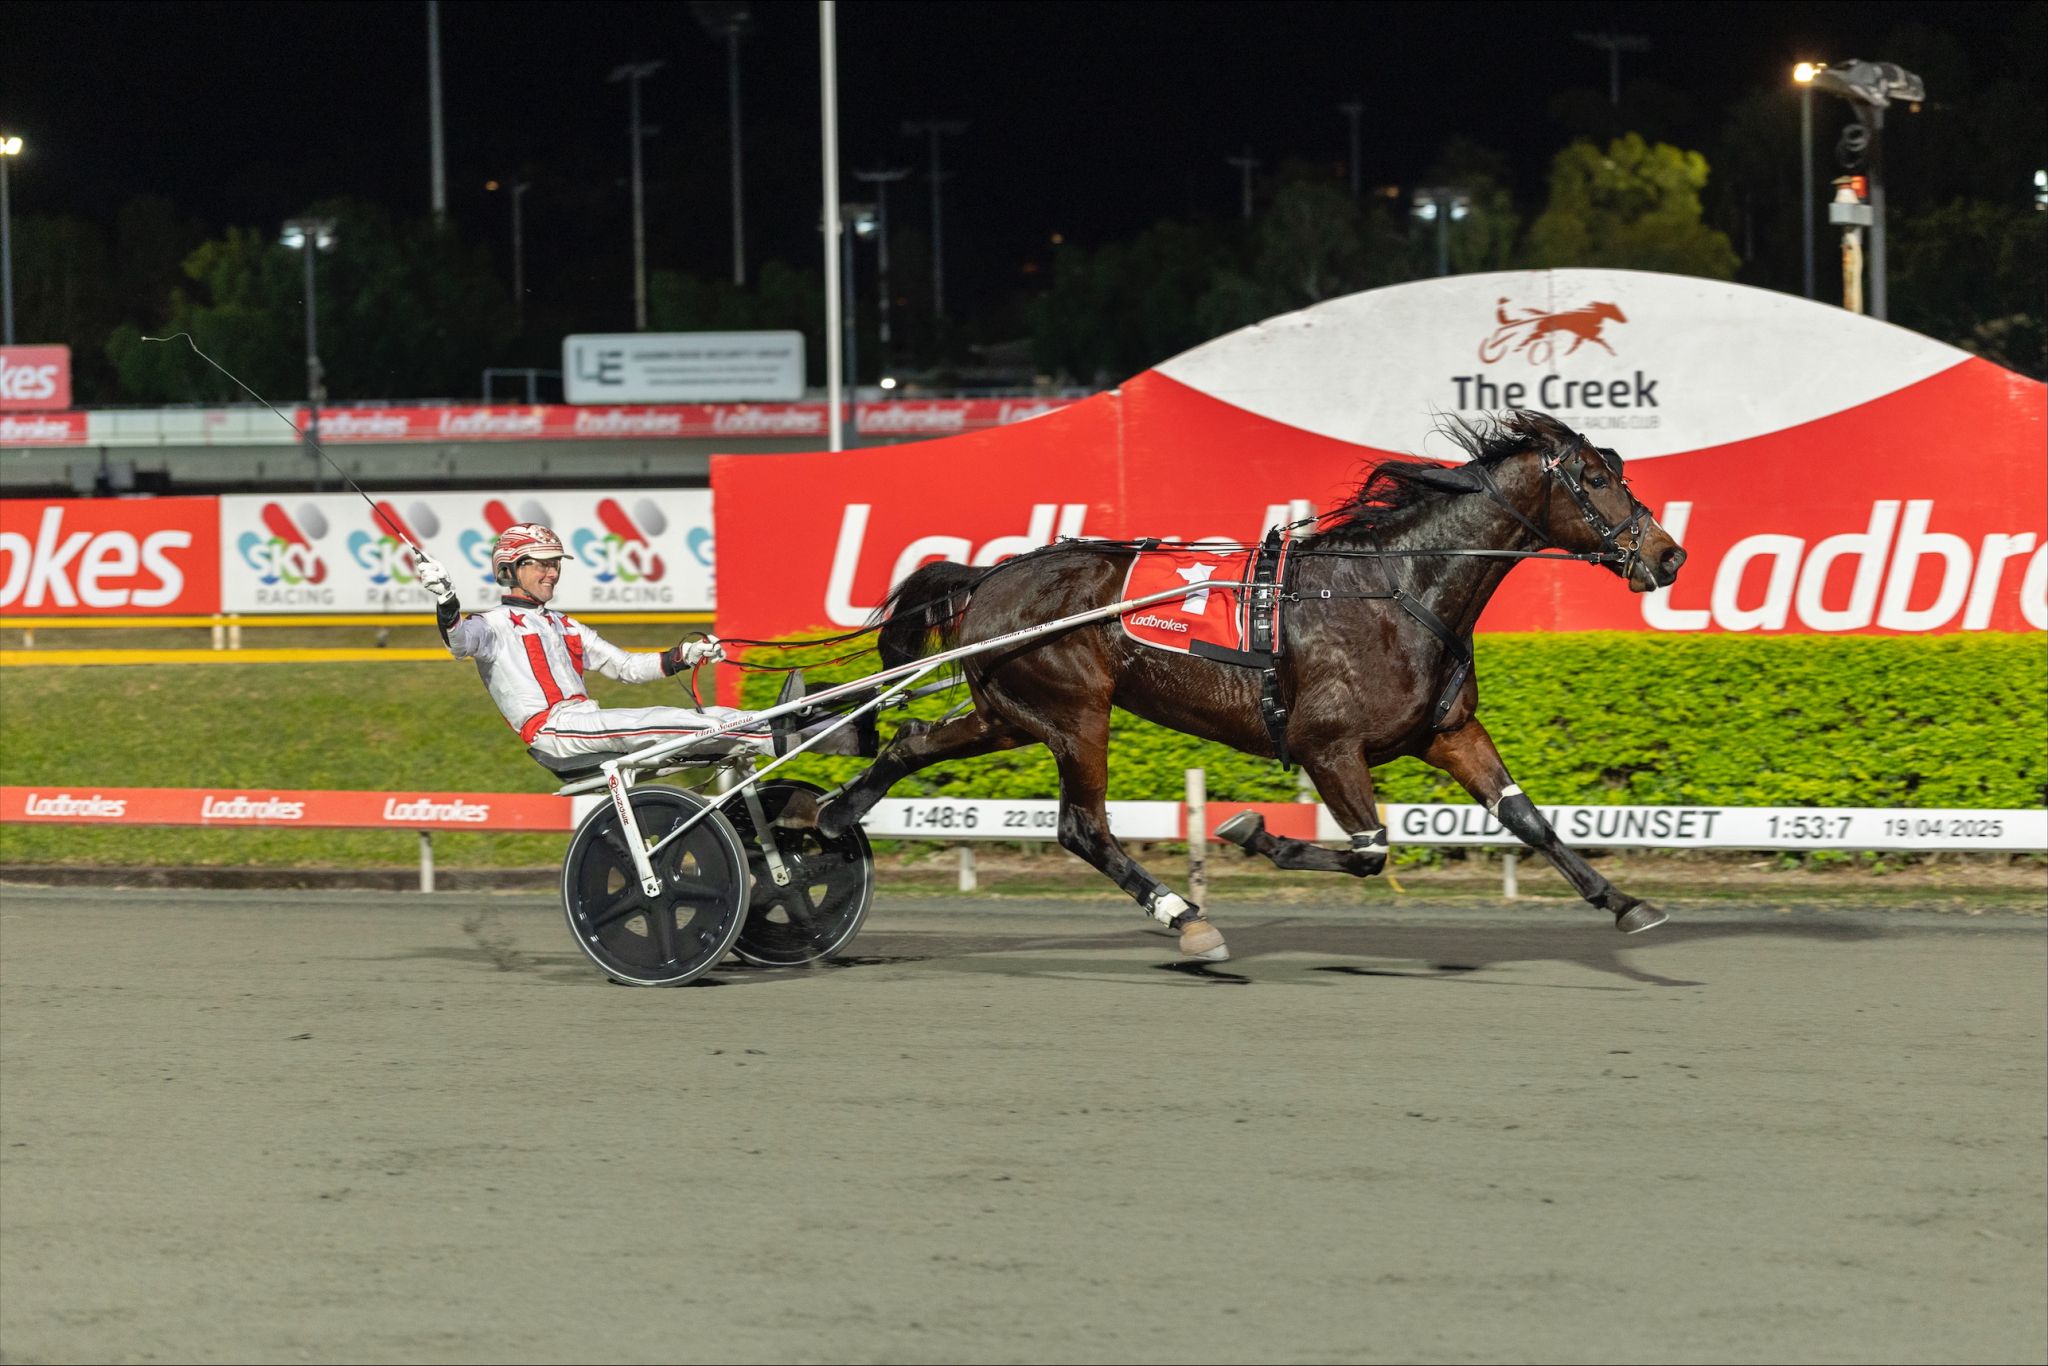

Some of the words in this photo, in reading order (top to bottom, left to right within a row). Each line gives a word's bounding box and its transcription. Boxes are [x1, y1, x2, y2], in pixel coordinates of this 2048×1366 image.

[1451, 374, 1526, 410] The
[1540, 370, 1659, 409] Creek
[256, 589, 334, 606] RACING
[592, 586, 673, 603] RACING
[1130, 613, 1188, 633] Ladbrokes
[694, 726, 717, 738] Chris
[25, 793, 127, 817] Ladbrokes
[201, 795, 304, 819] Ladbrokes
[383, 798, 489, 822] Ladbrokes
[902, 806, 979, 829] 1:48:6
[1402, 807, 1559, 837] GOLD
[1570, 809, 1721, 839] SUNSET
[1768, 815, 1852, 839] 1:53:7
